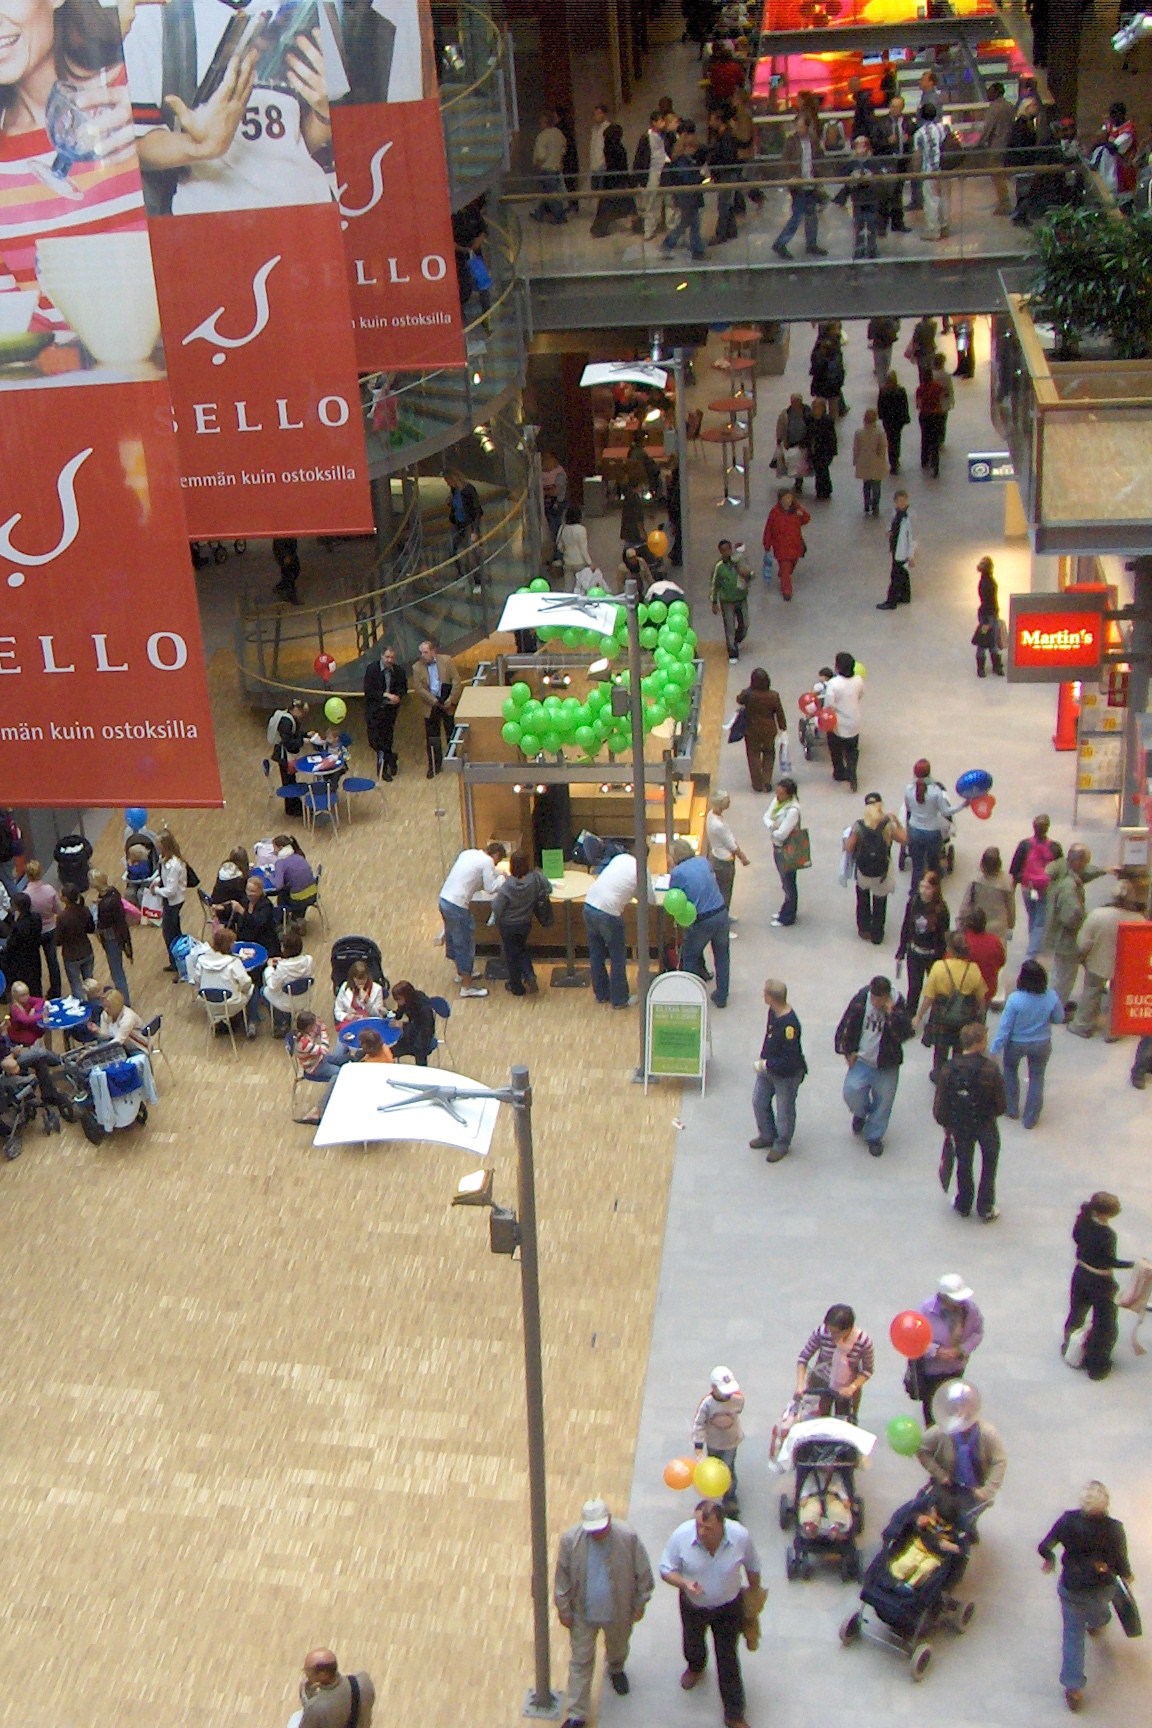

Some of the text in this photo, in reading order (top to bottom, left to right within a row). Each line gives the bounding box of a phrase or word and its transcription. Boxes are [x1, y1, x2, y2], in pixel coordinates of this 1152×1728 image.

[241, 104, 286, 141] 58
[354, 254, 447, 285] LLO
[359, 312, 451, 328] kuin ostoksilla
[180, 464, 356, 488] emmän kuin ostoksilla
[1020, 629, 1094, 645] Martin's
[49, 720, 95, 740] kuin
[101, 719, 198, 740] ostoksilla
